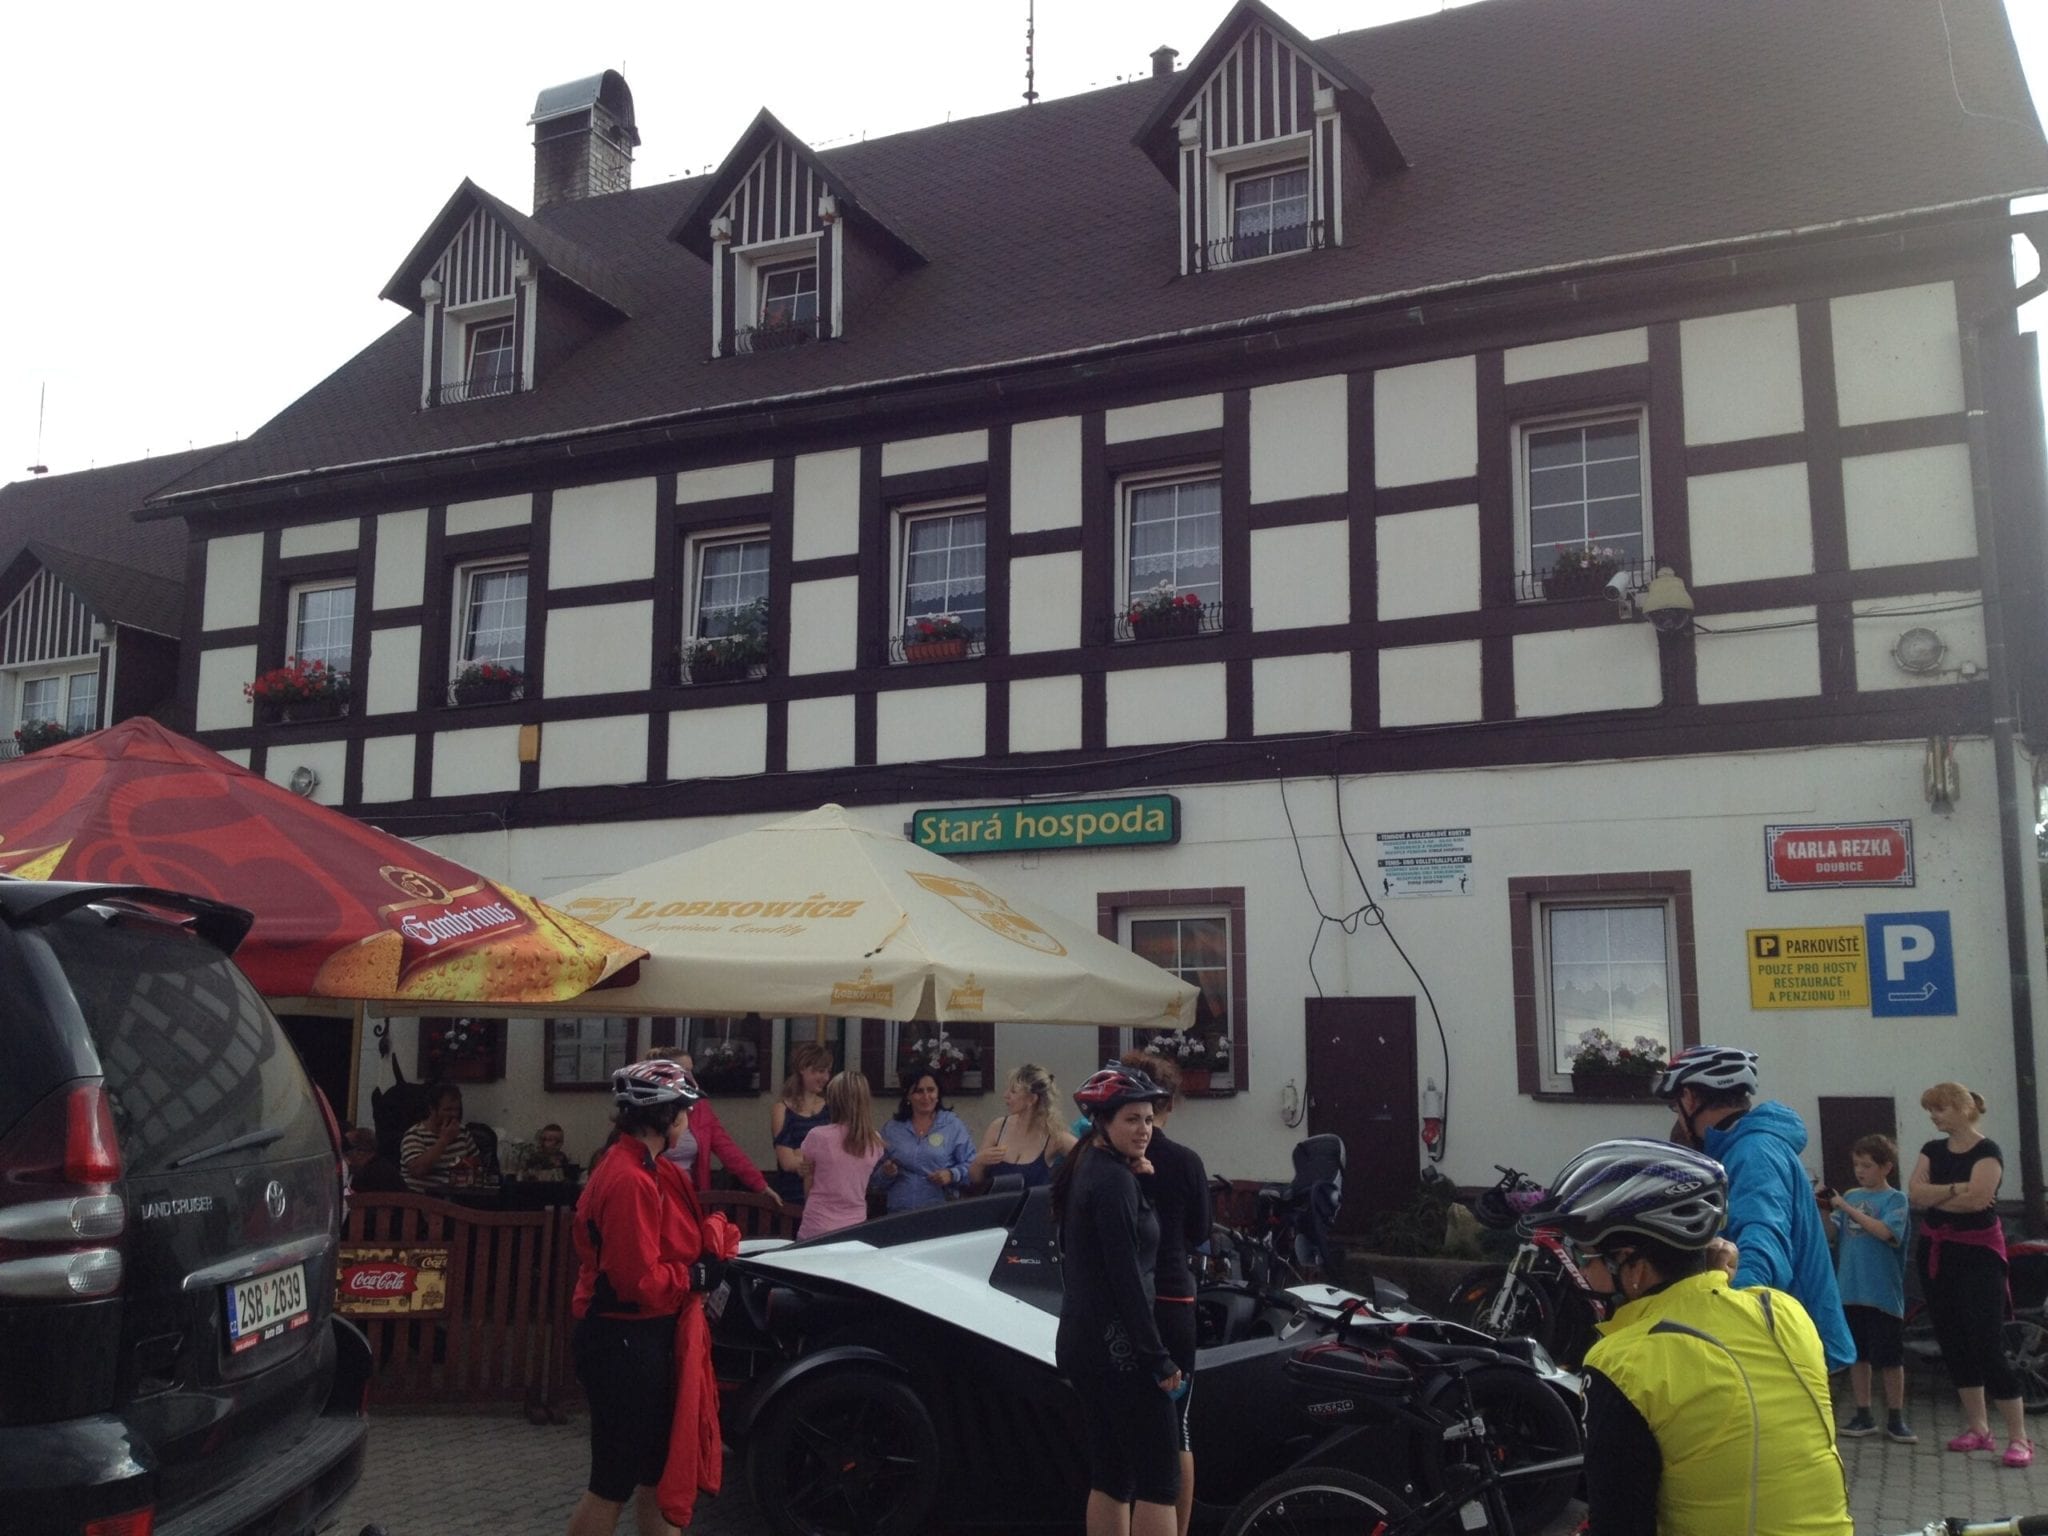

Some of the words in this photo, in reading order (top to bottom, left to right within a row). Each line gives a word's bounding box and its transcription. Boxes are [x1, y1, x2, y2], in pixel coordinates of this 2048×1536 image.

[921, 812, 1002, 844] Stará
[1015, 804, 1165, 844] hospoda
[1787, 841, 1837, 859] KARLA
[1841, 838, 1892, 857] REZKA
[1815, 861, 1864, 873] DOUBICE
[625, 893, 865, 920] LOBKOWICZ
[402, 902, 517, 946] Gambrinus
[1786, 935, 1860, 954] PARKOVIŠTĚ
[1883, 924, 1935, 981] P
[1758, 963, 1793, 976] POUZE
[1797, 962, 1820, 974] PRO
[1823, 961, 1858, 973] HOSTY
[1774, 976, 1844, 989] RESTAURACE
[1768, 991, 1776, 1002] A
[1779, 989, 1835, 1002] PENZIONU
[1665, 1181, 1702, 1196] KED
[141, 1200, 172, 1220] LAND
[172, 1196, 213, 1215] CRUISER
[351, 1271, 407, 1290] Coca-Cola
[239, 1286, 264, 1330] 2SB
[272, 1272, 302, 1316] 2639
[229, 1320, 238, 1333] CZ
